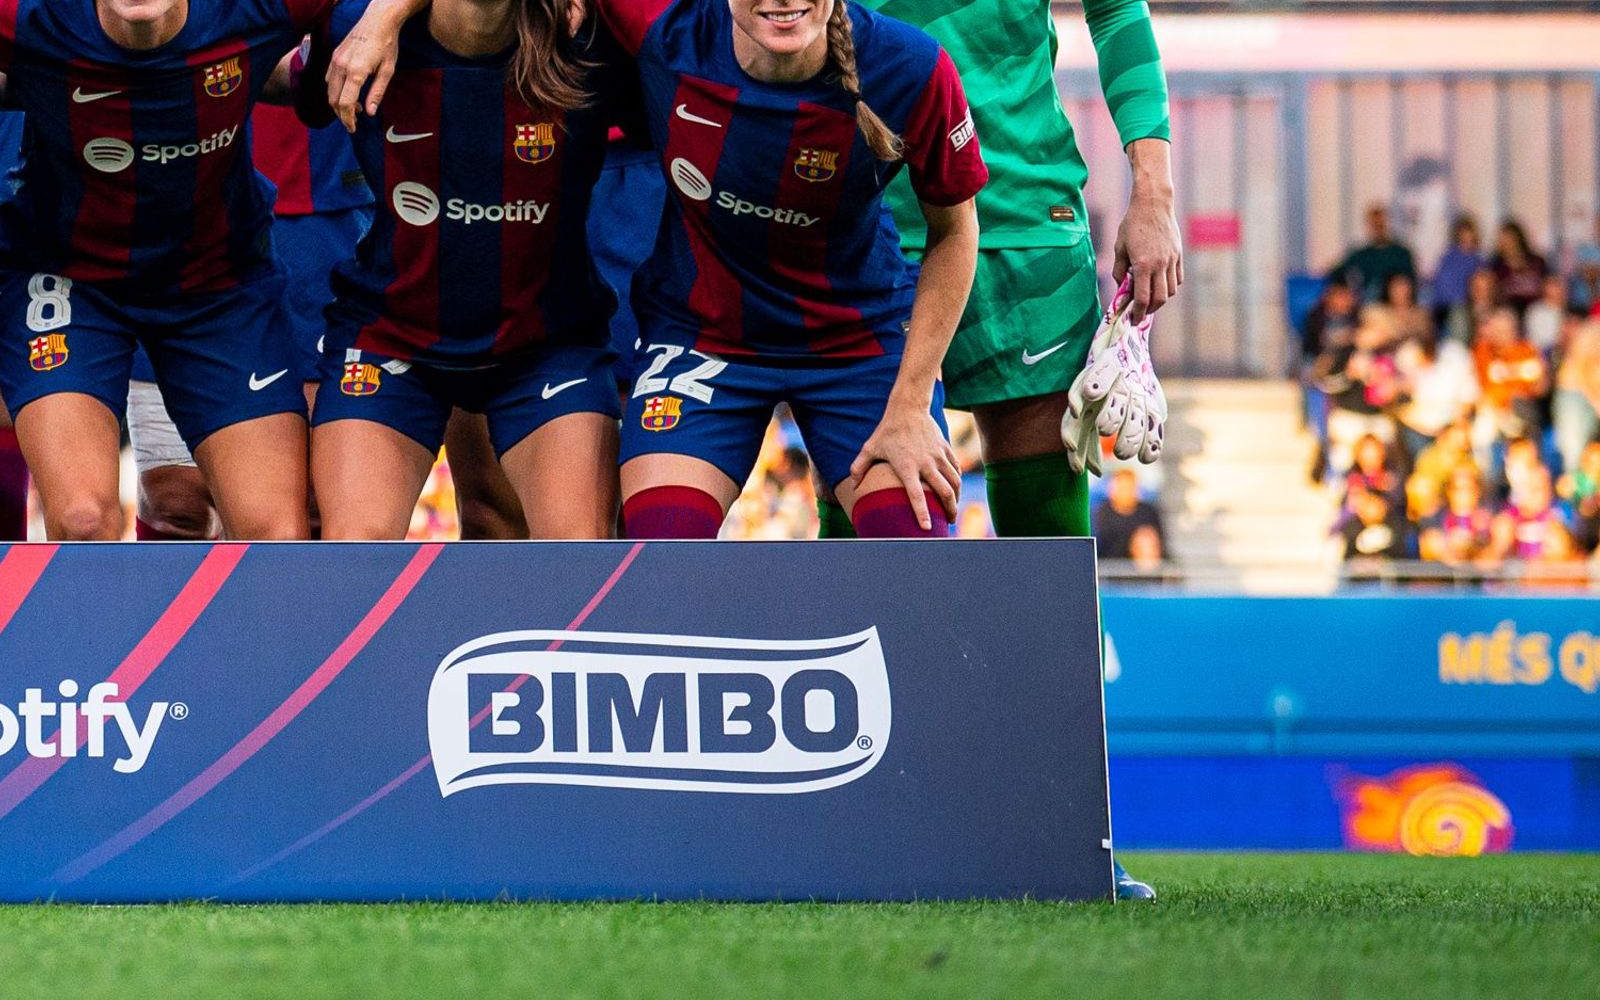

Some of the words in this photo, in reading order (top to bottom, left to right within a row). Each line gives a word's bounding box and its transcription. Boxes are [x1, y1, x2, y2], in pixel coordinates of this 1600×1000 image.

[142, 123, 238, 163] Spotify
[446, 199, 550, 224] Spotify
[715, 190, 821, 227] Spotify
[26, 273, 72, 332] 8
[632, 343, 728, 404] 22
[1438, 618, 1553, 685] MÉS
[1559, 630, 1600, 693] Q
